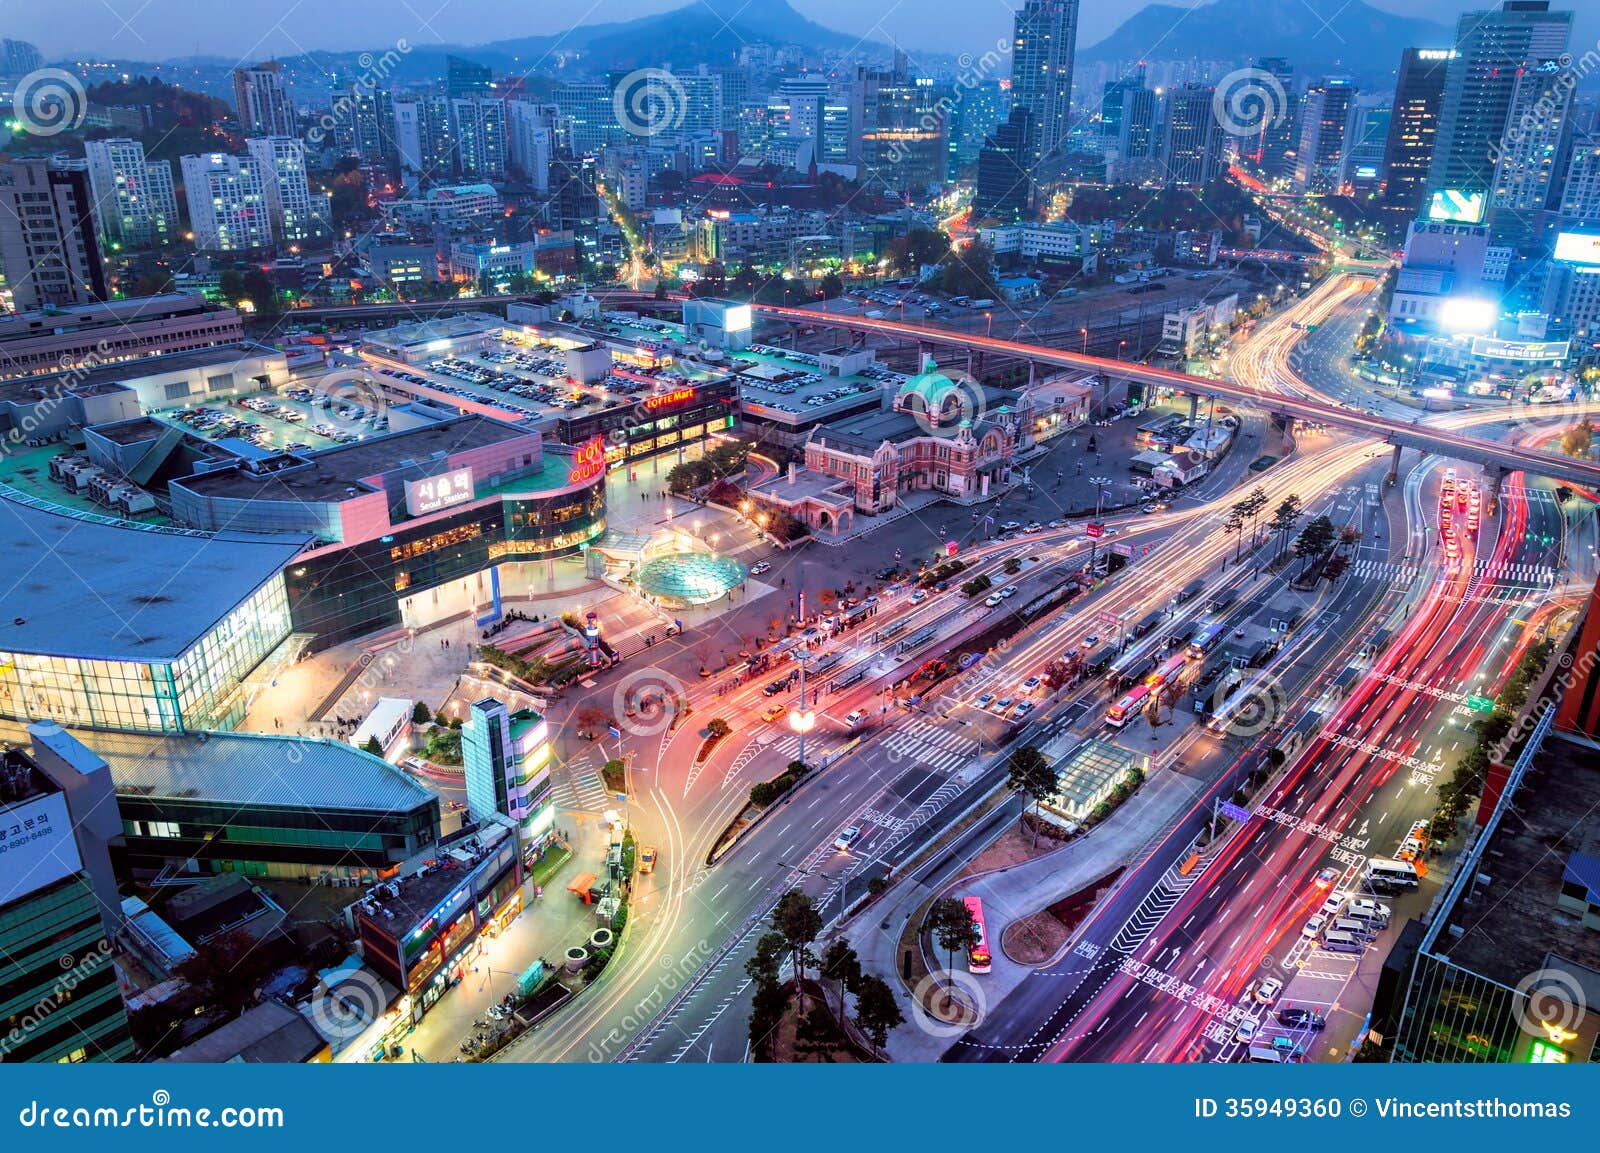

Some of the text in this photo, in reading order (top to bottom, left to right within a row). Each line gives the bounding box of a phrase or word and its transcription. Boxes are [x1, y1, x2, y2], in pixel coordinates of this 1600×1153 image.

[647, 388, 694, 409] LOTTE Mart
[419, 472, 469, 500] 서울역
[419, 491, 469, 511] Seoul Station
[0, 826, 53, 854] 0-8901-5498
